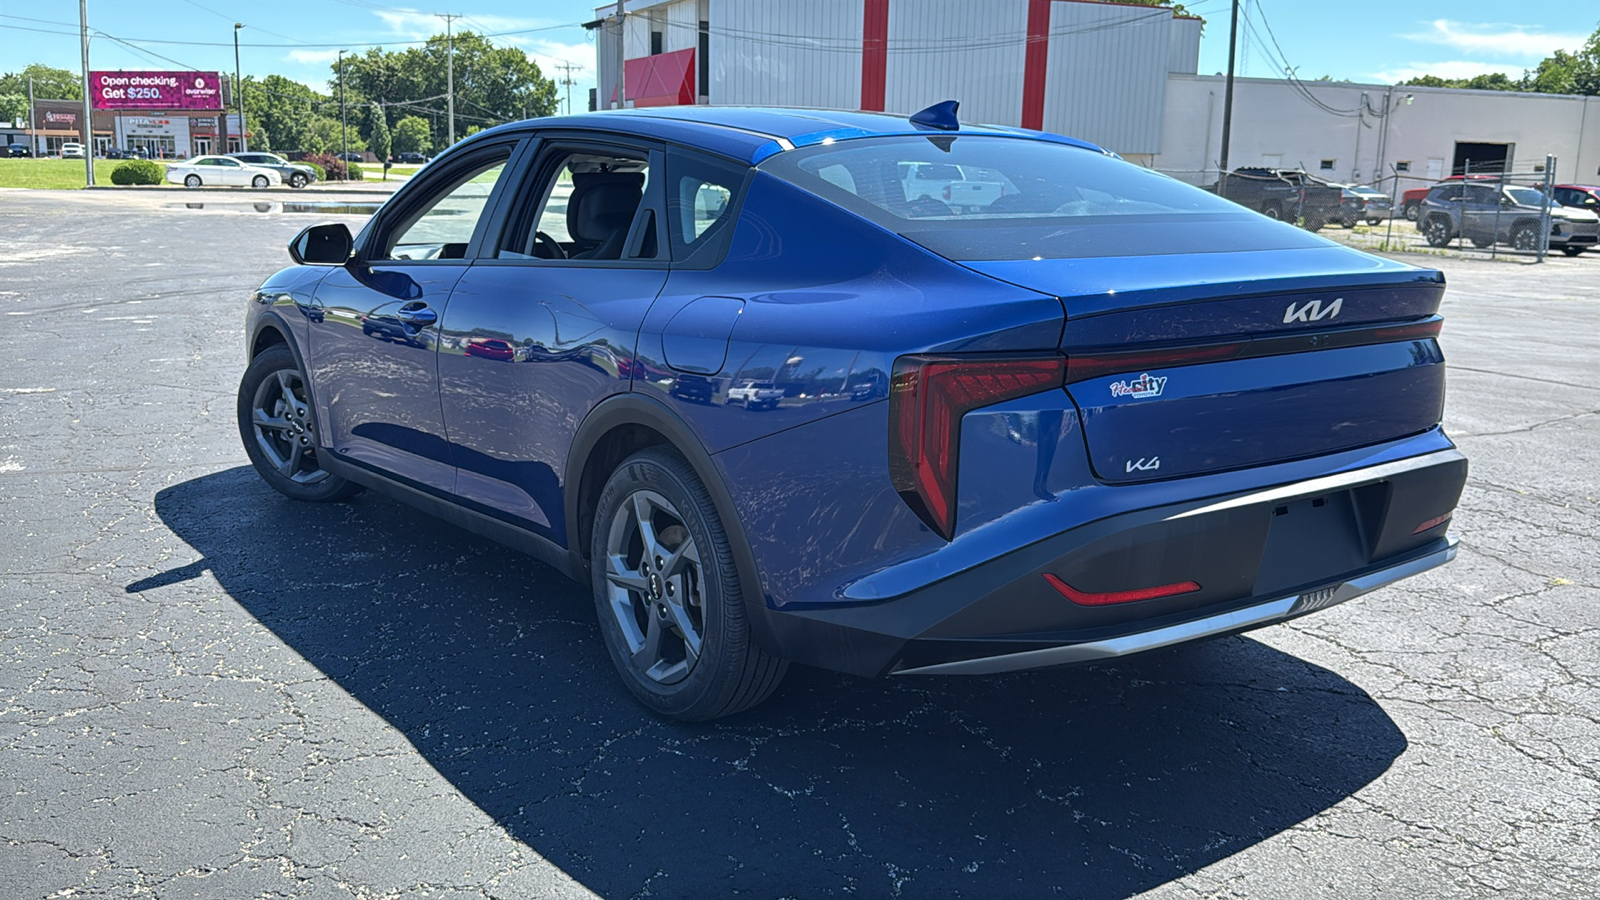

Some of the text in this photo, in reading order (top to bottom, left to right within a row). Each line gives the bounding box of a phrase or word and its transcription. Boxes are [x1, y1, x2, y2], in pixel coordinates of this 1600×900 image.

[100, 75, 178, 87] Open checking.
[102, 86, 162, 100] Get $250.
[1282, 297, 1343, 324] KIA
[1126, 456, 1160, 473] K4
